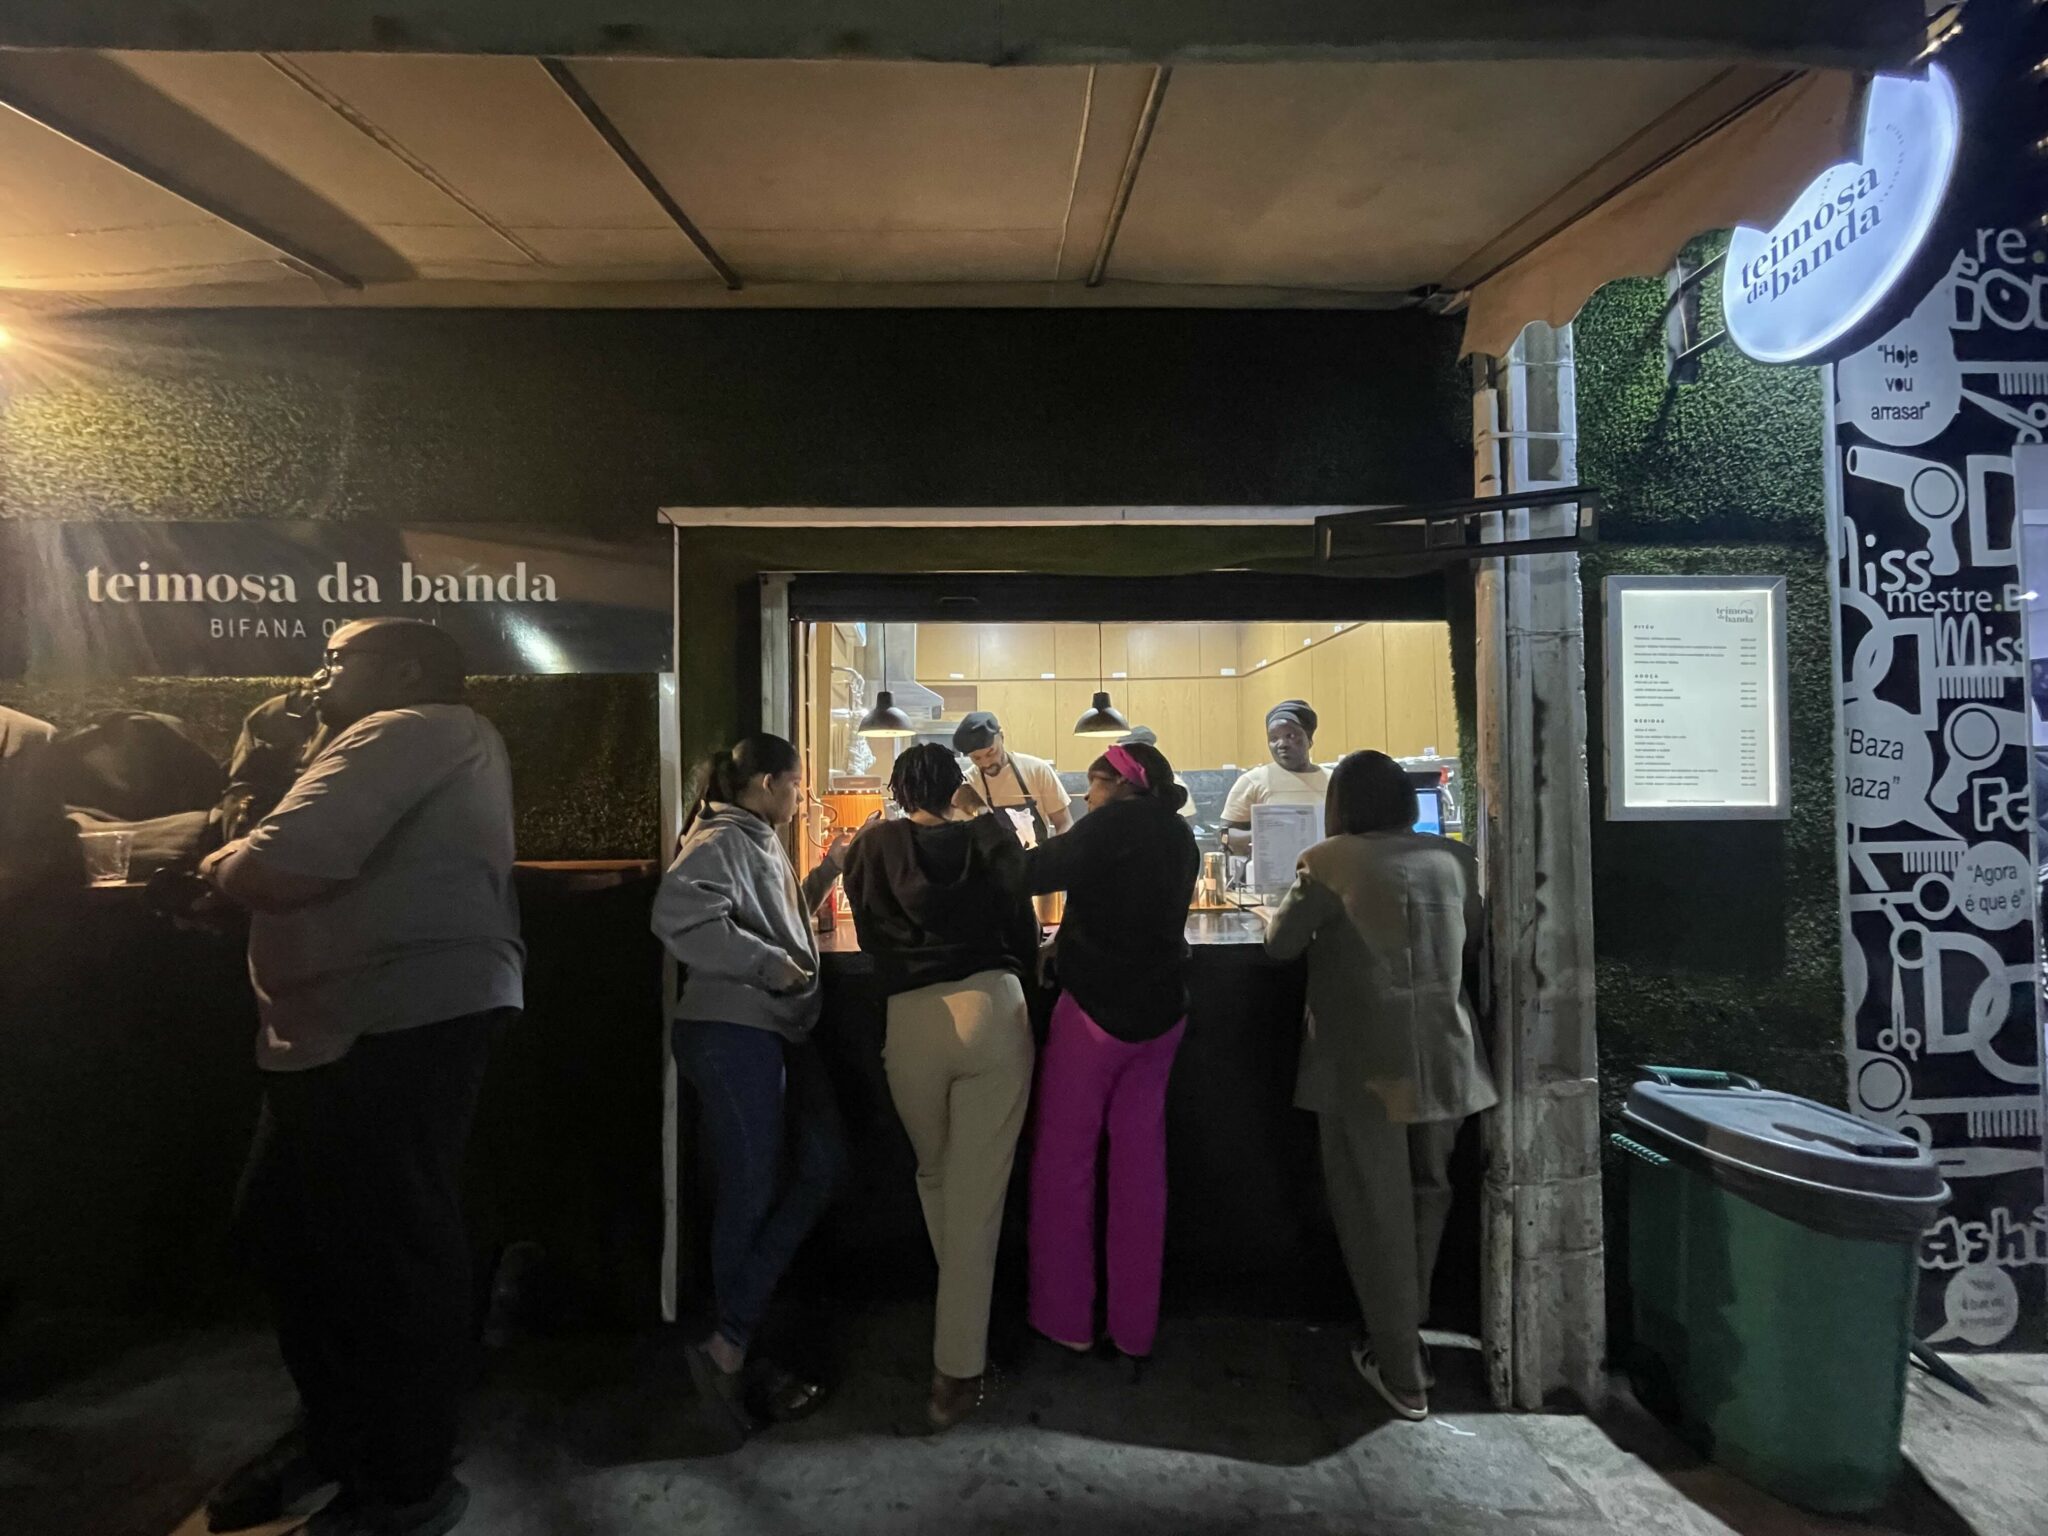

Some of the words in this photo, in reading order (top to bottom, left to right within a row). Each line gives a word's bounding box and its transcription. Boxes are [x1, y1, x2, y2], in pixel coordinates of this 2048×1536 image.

[1742, 168, 1880, 289] teimosa
[1746, 280, 1768, 304] da
[1771, 205, 1881, 302] banda
[1885, 377, 1913, 392] vou
[85, 561, 298, 603] teimosa
[317, 561, 380, 603] da
[401, 561, 559, 603] banda
[210, 618, 307, 638] BIFANA
[1979, 895, 2007, 916] que
